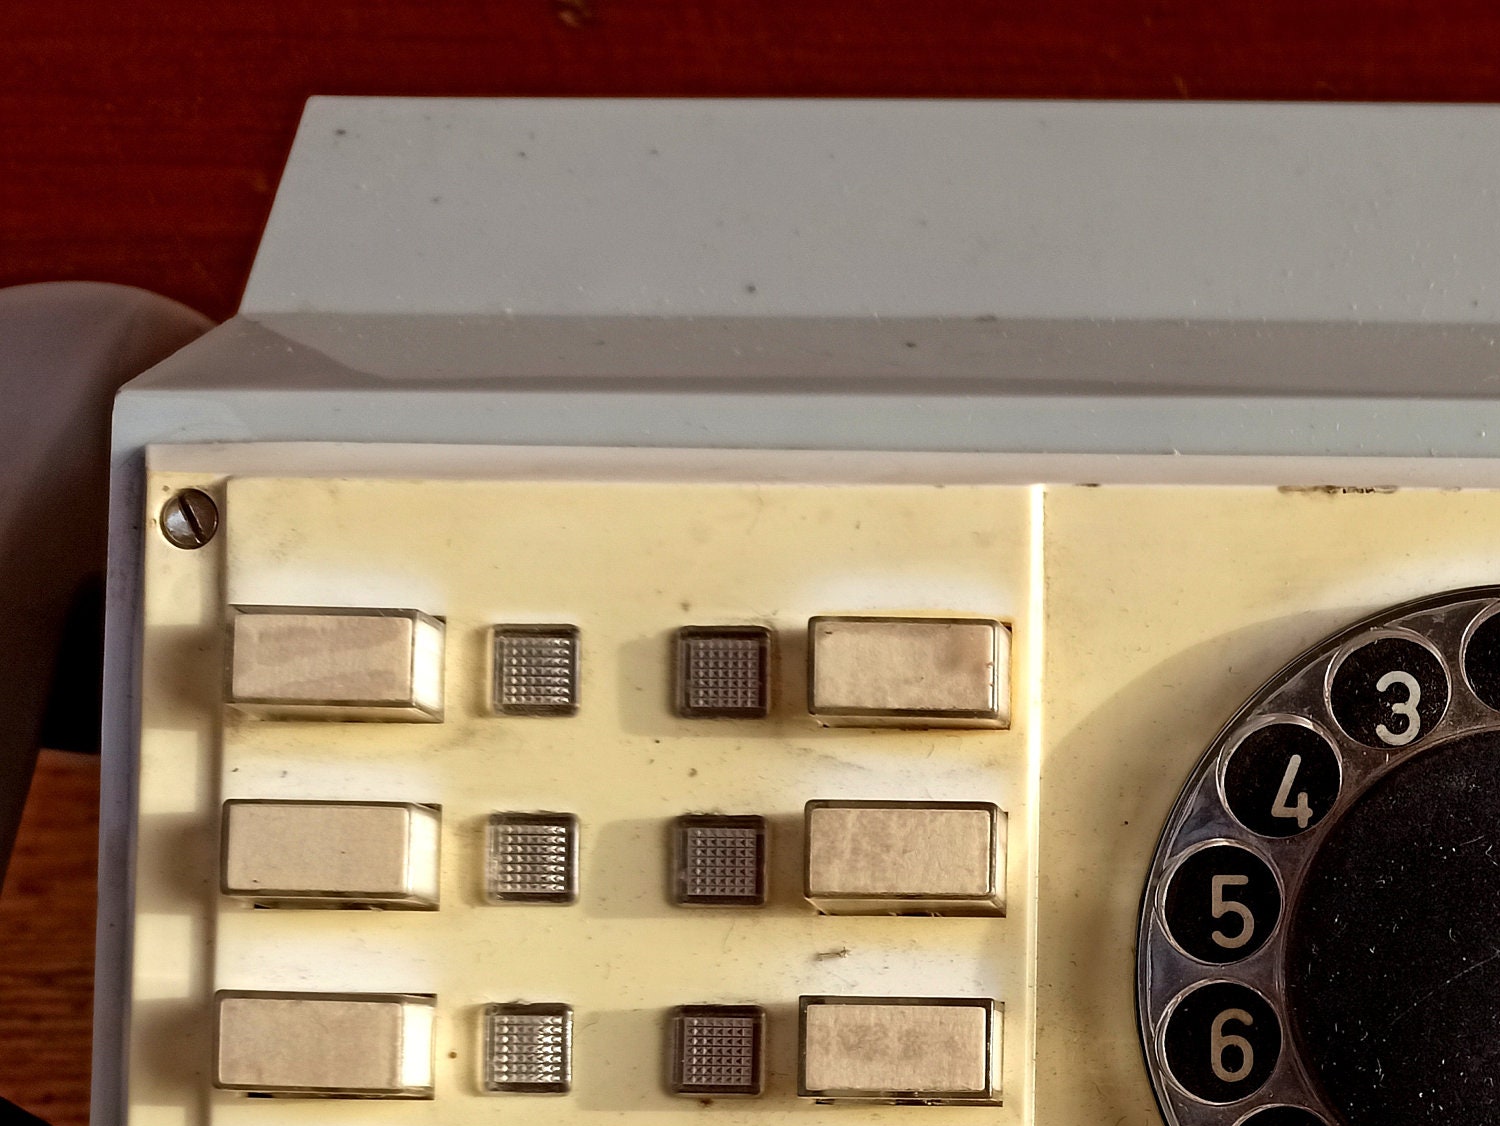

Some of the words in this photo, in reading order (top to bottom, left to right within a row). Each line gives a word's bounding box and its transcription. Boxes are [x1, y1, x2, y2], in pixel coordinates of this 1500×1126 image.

[1376, 670, 1421, 747] 3
[1271, 754, 1314, 829] 4
[1210, 874, 1255, 949] 5
[1210, 1008, 1254, 1083] 6
